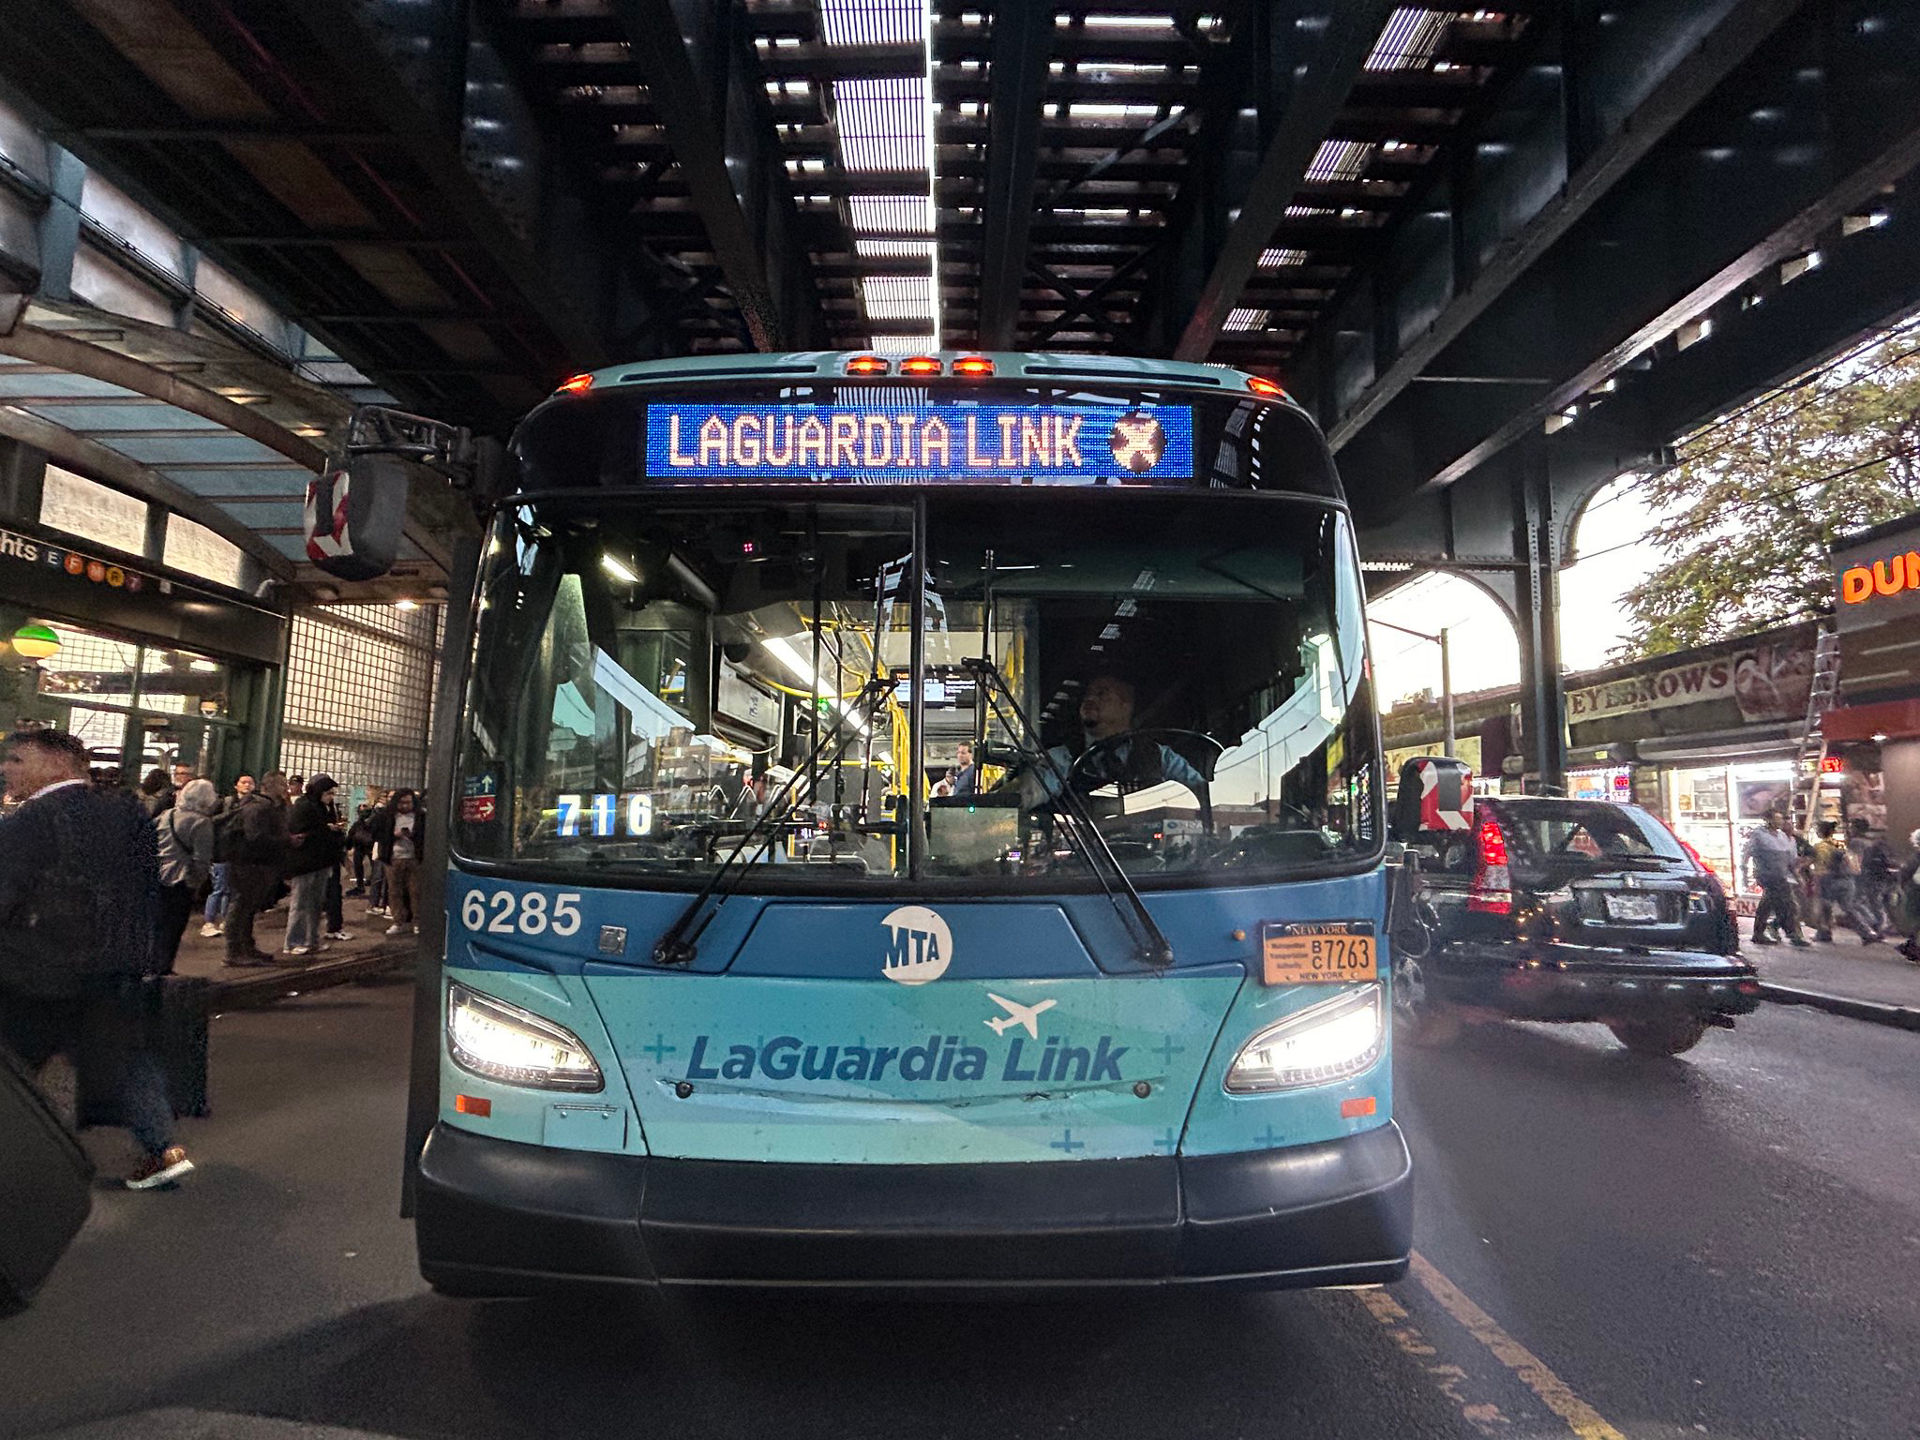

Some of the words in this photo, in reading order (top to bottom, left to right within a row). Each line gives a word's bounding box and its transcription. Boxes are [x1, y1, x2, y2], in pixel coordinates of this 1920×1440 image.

[669, 413, 950, 467] LAGUARDIA
[966, 414, 1083, 467] LINK
[47, 551, 58, 565] E
[1571, 663, 1729, 714] EYEBROWS
[462, 889, 581, 936] 6285
[1292, 924, 1317, 935] NEW
[1320, 924, 1349, 935] YORK
[882, 923, 940, 969] MTA
[686, 1035, 988, 1081] LaGuardia
[1002, 1035, 1130, 1081] Link
